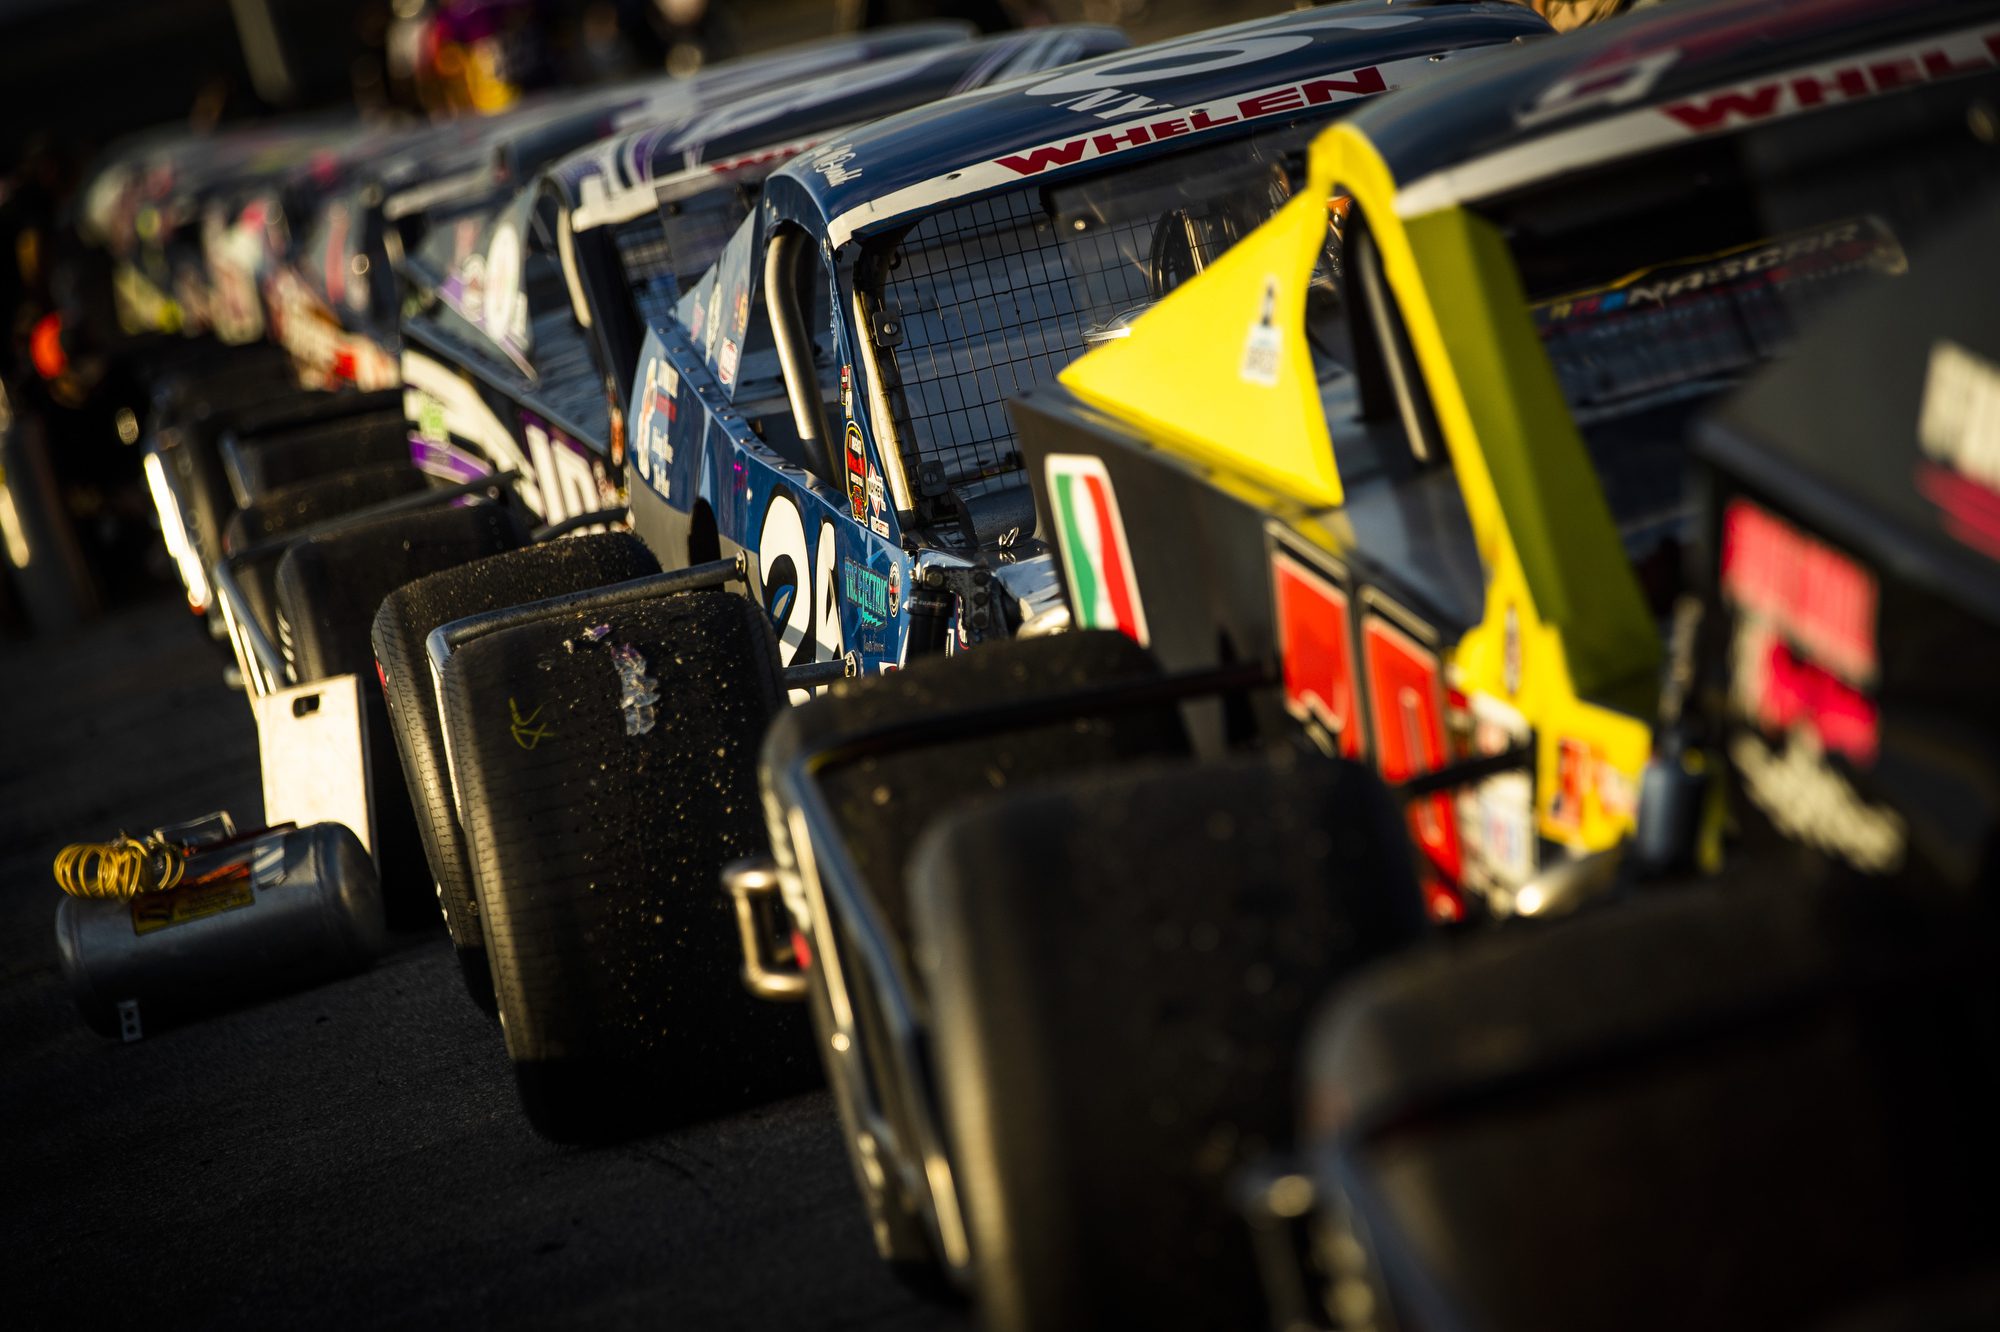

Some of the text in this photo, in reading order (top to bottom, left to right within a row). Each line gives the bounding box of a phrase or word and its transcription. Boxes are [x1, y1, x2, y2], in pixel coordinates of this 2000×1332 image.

[994, 66, 1388, 177] WHELEN
[1663, 32, 2000, 133] WHEL
[1627, 222, 1858, 306] NASCAR
